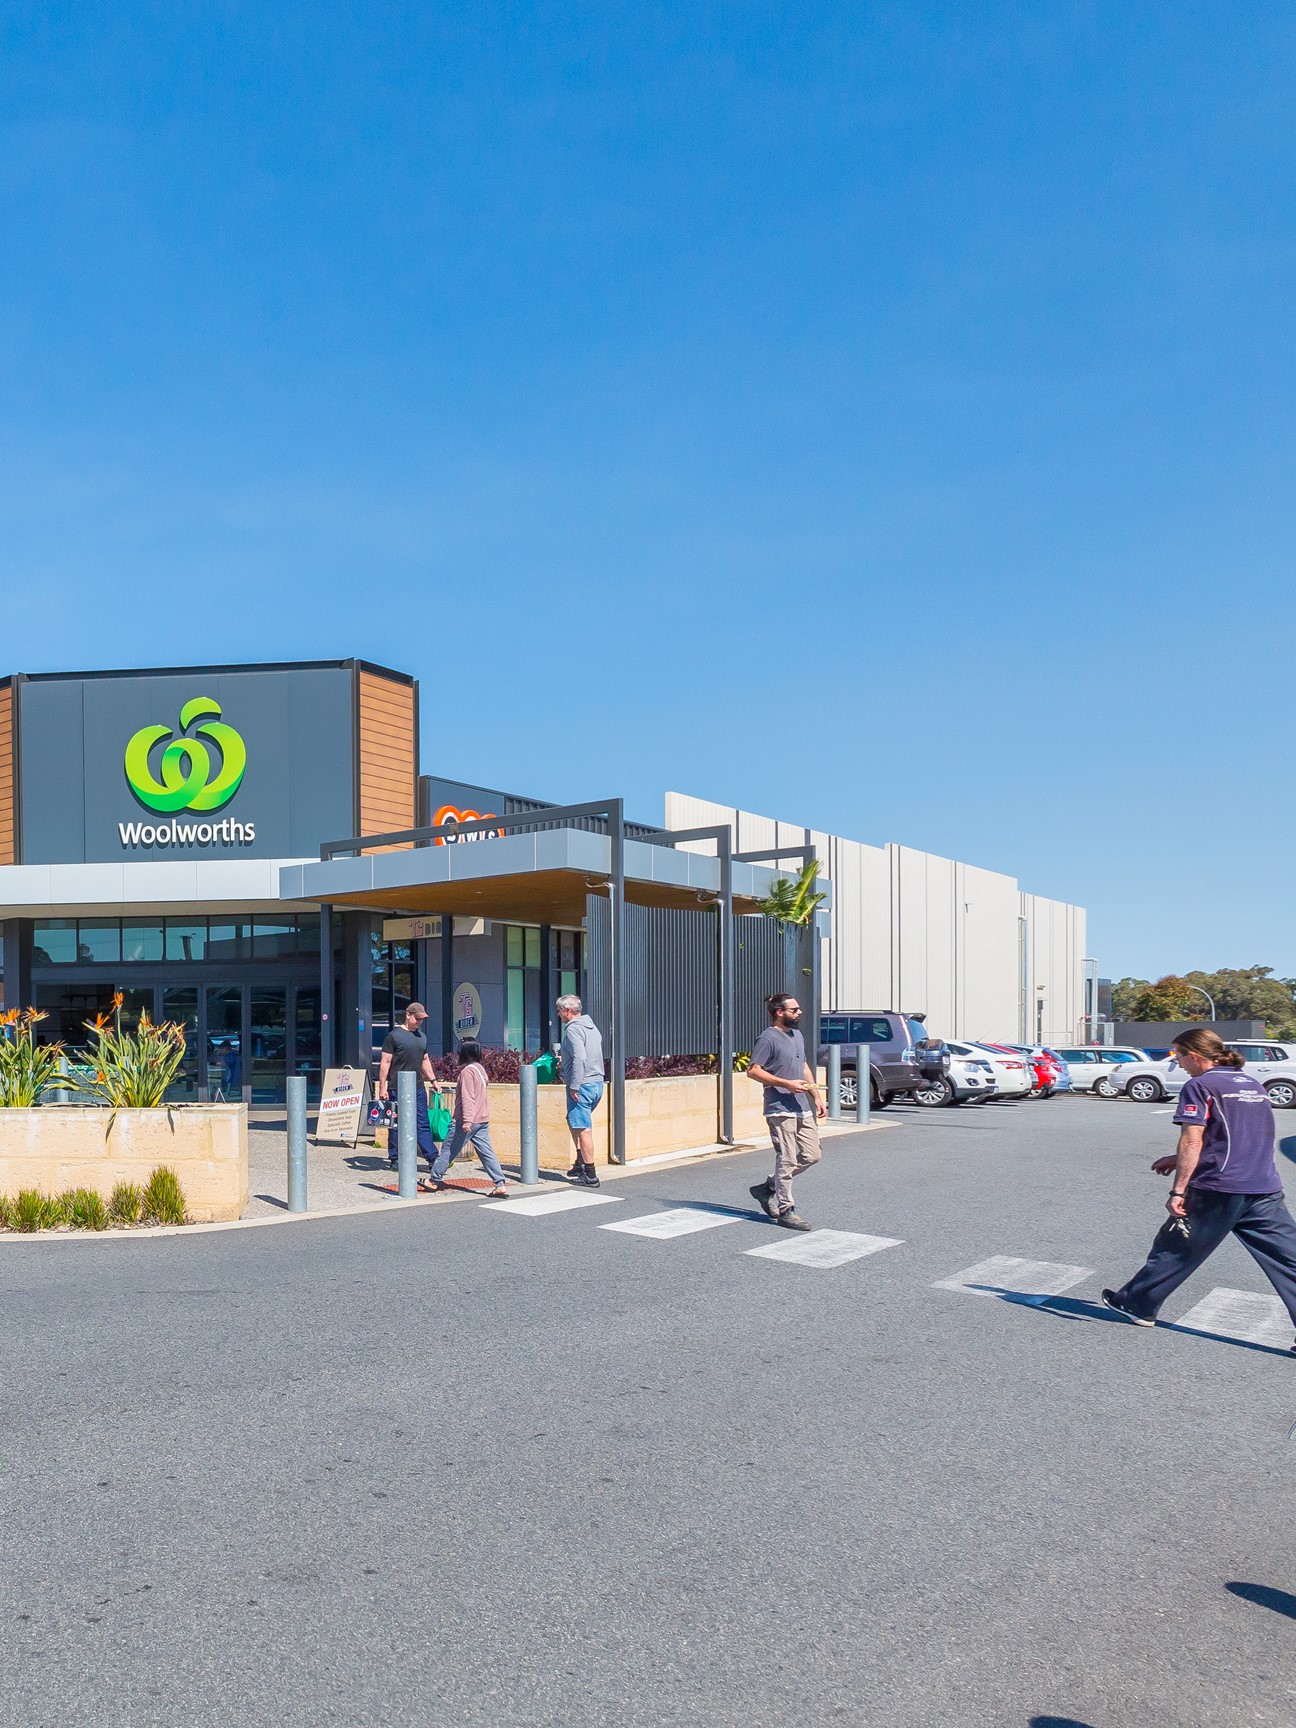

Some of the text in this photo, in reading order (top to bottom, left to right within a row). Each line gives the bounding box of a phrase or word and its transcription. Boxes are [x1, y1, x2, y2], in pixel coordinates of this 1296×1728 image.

[118, 817, 256, 844] Woolworths
[323, 1096, 360, 1110] NOW OPEN
